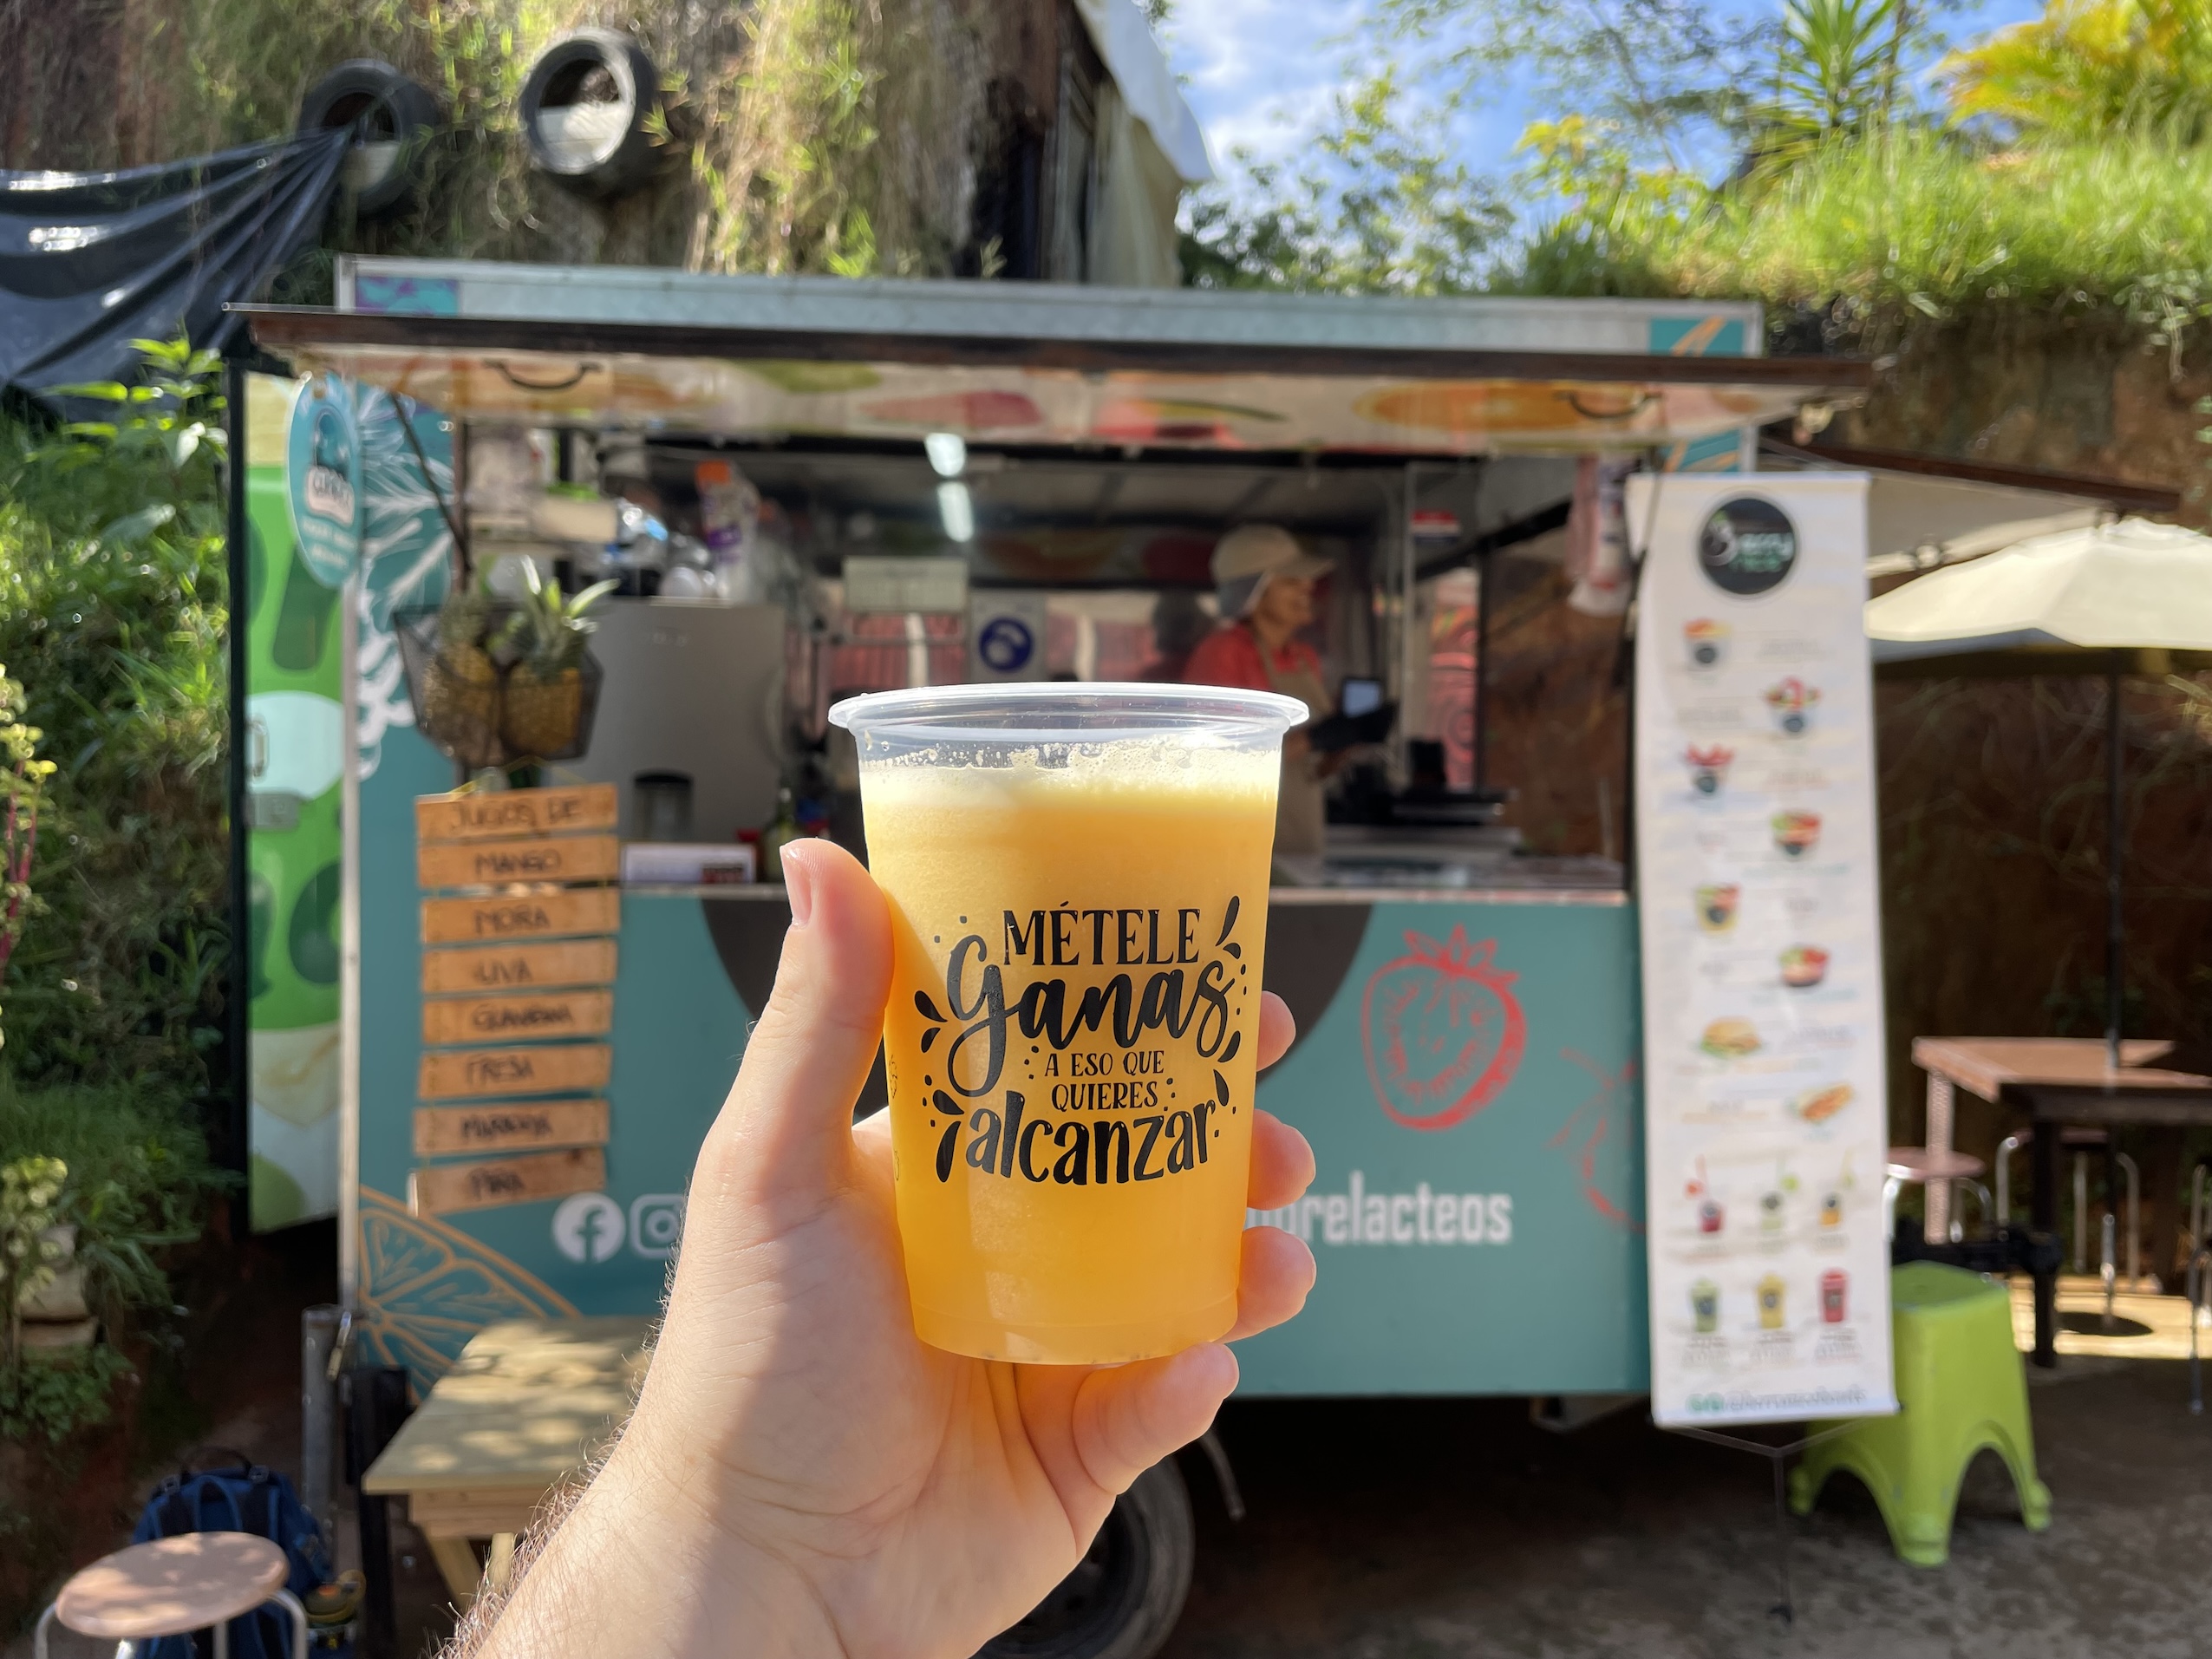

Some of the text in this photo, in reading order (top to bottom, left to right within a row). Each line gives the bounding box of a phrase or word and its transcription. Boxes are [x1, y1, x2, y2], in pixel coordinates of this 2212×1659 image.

[474, 904, 551, 936] MORA
[1002, 901, 1201, 966] MÉTELE
[1044, 1050, 1165, 1077] A ESO QUE
[1051, 1081, 1158, 1112] QUIERES
[965, 1090, 1217, 1185] alcanzar
